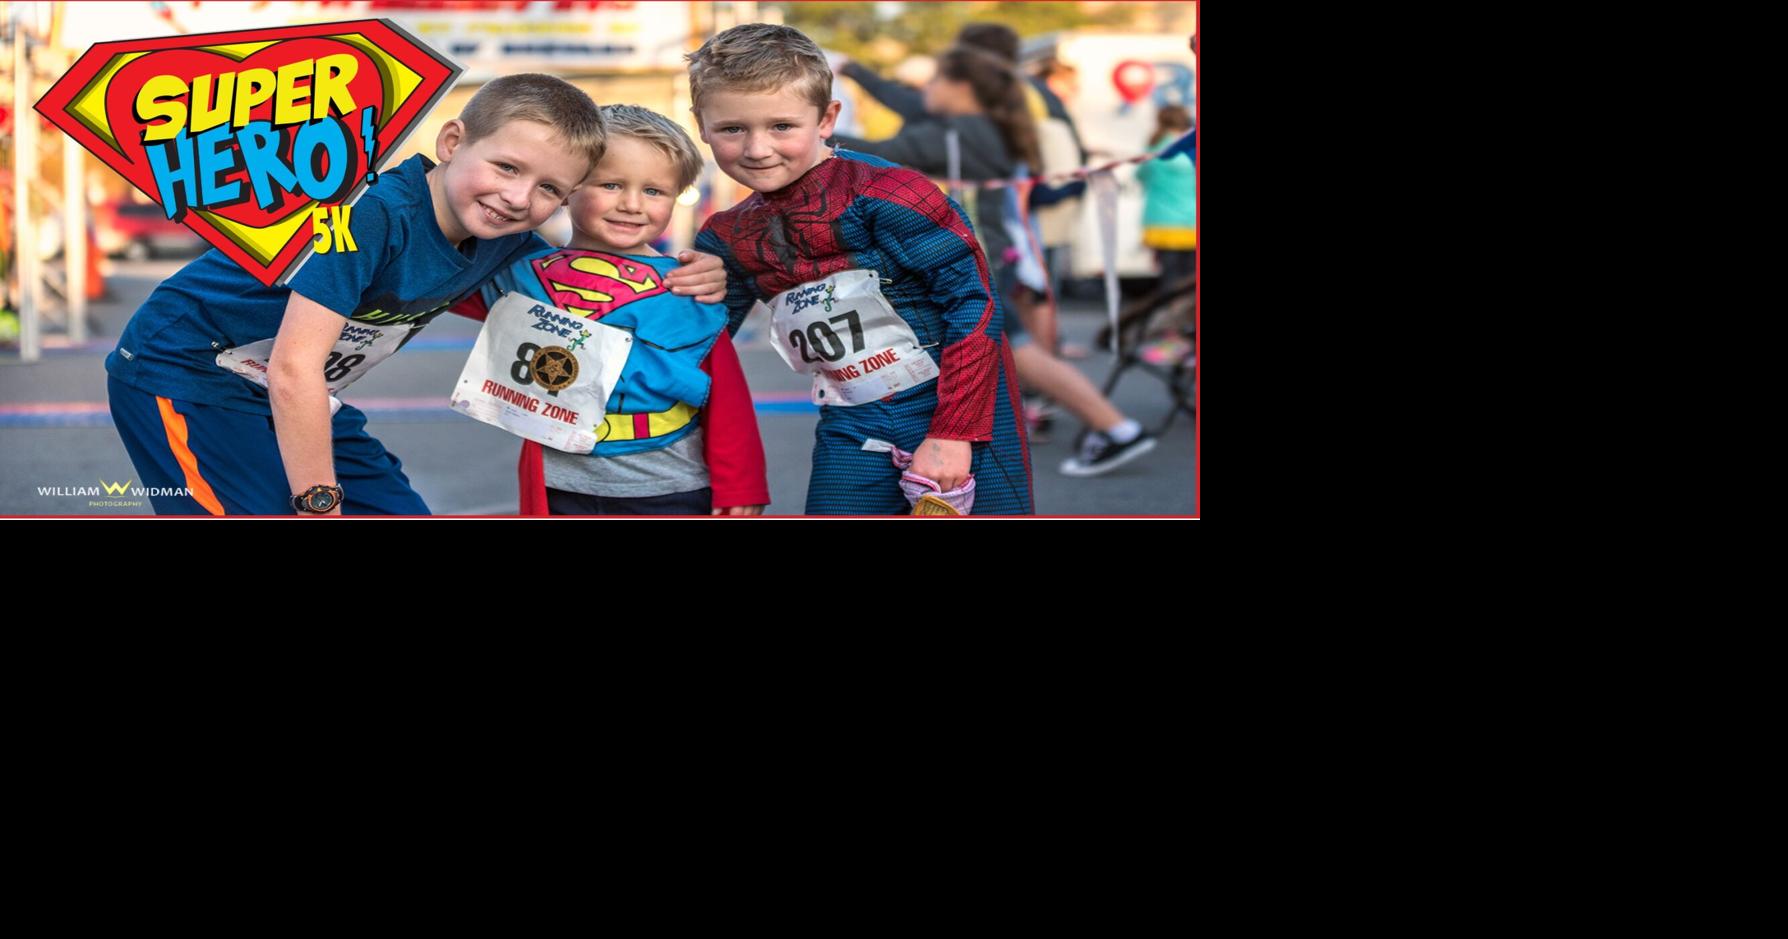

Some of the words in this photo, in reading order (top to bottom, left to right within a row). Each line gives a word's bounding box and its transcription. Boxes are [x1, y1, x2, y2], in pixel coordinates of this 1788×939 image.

[786, 283, 826, 306] RUNNING
[792, 295, 820, 315] ZONE
[527, 304, 584, 330] RUNNING
[531, 318, 572, 338] ZONE
[788, 309, 866, 364] 207
[858, 347, 901, 374] ZONE
[481, 379, 540, 413] RUNNING
[541, 402, 580, 425] ZONE
